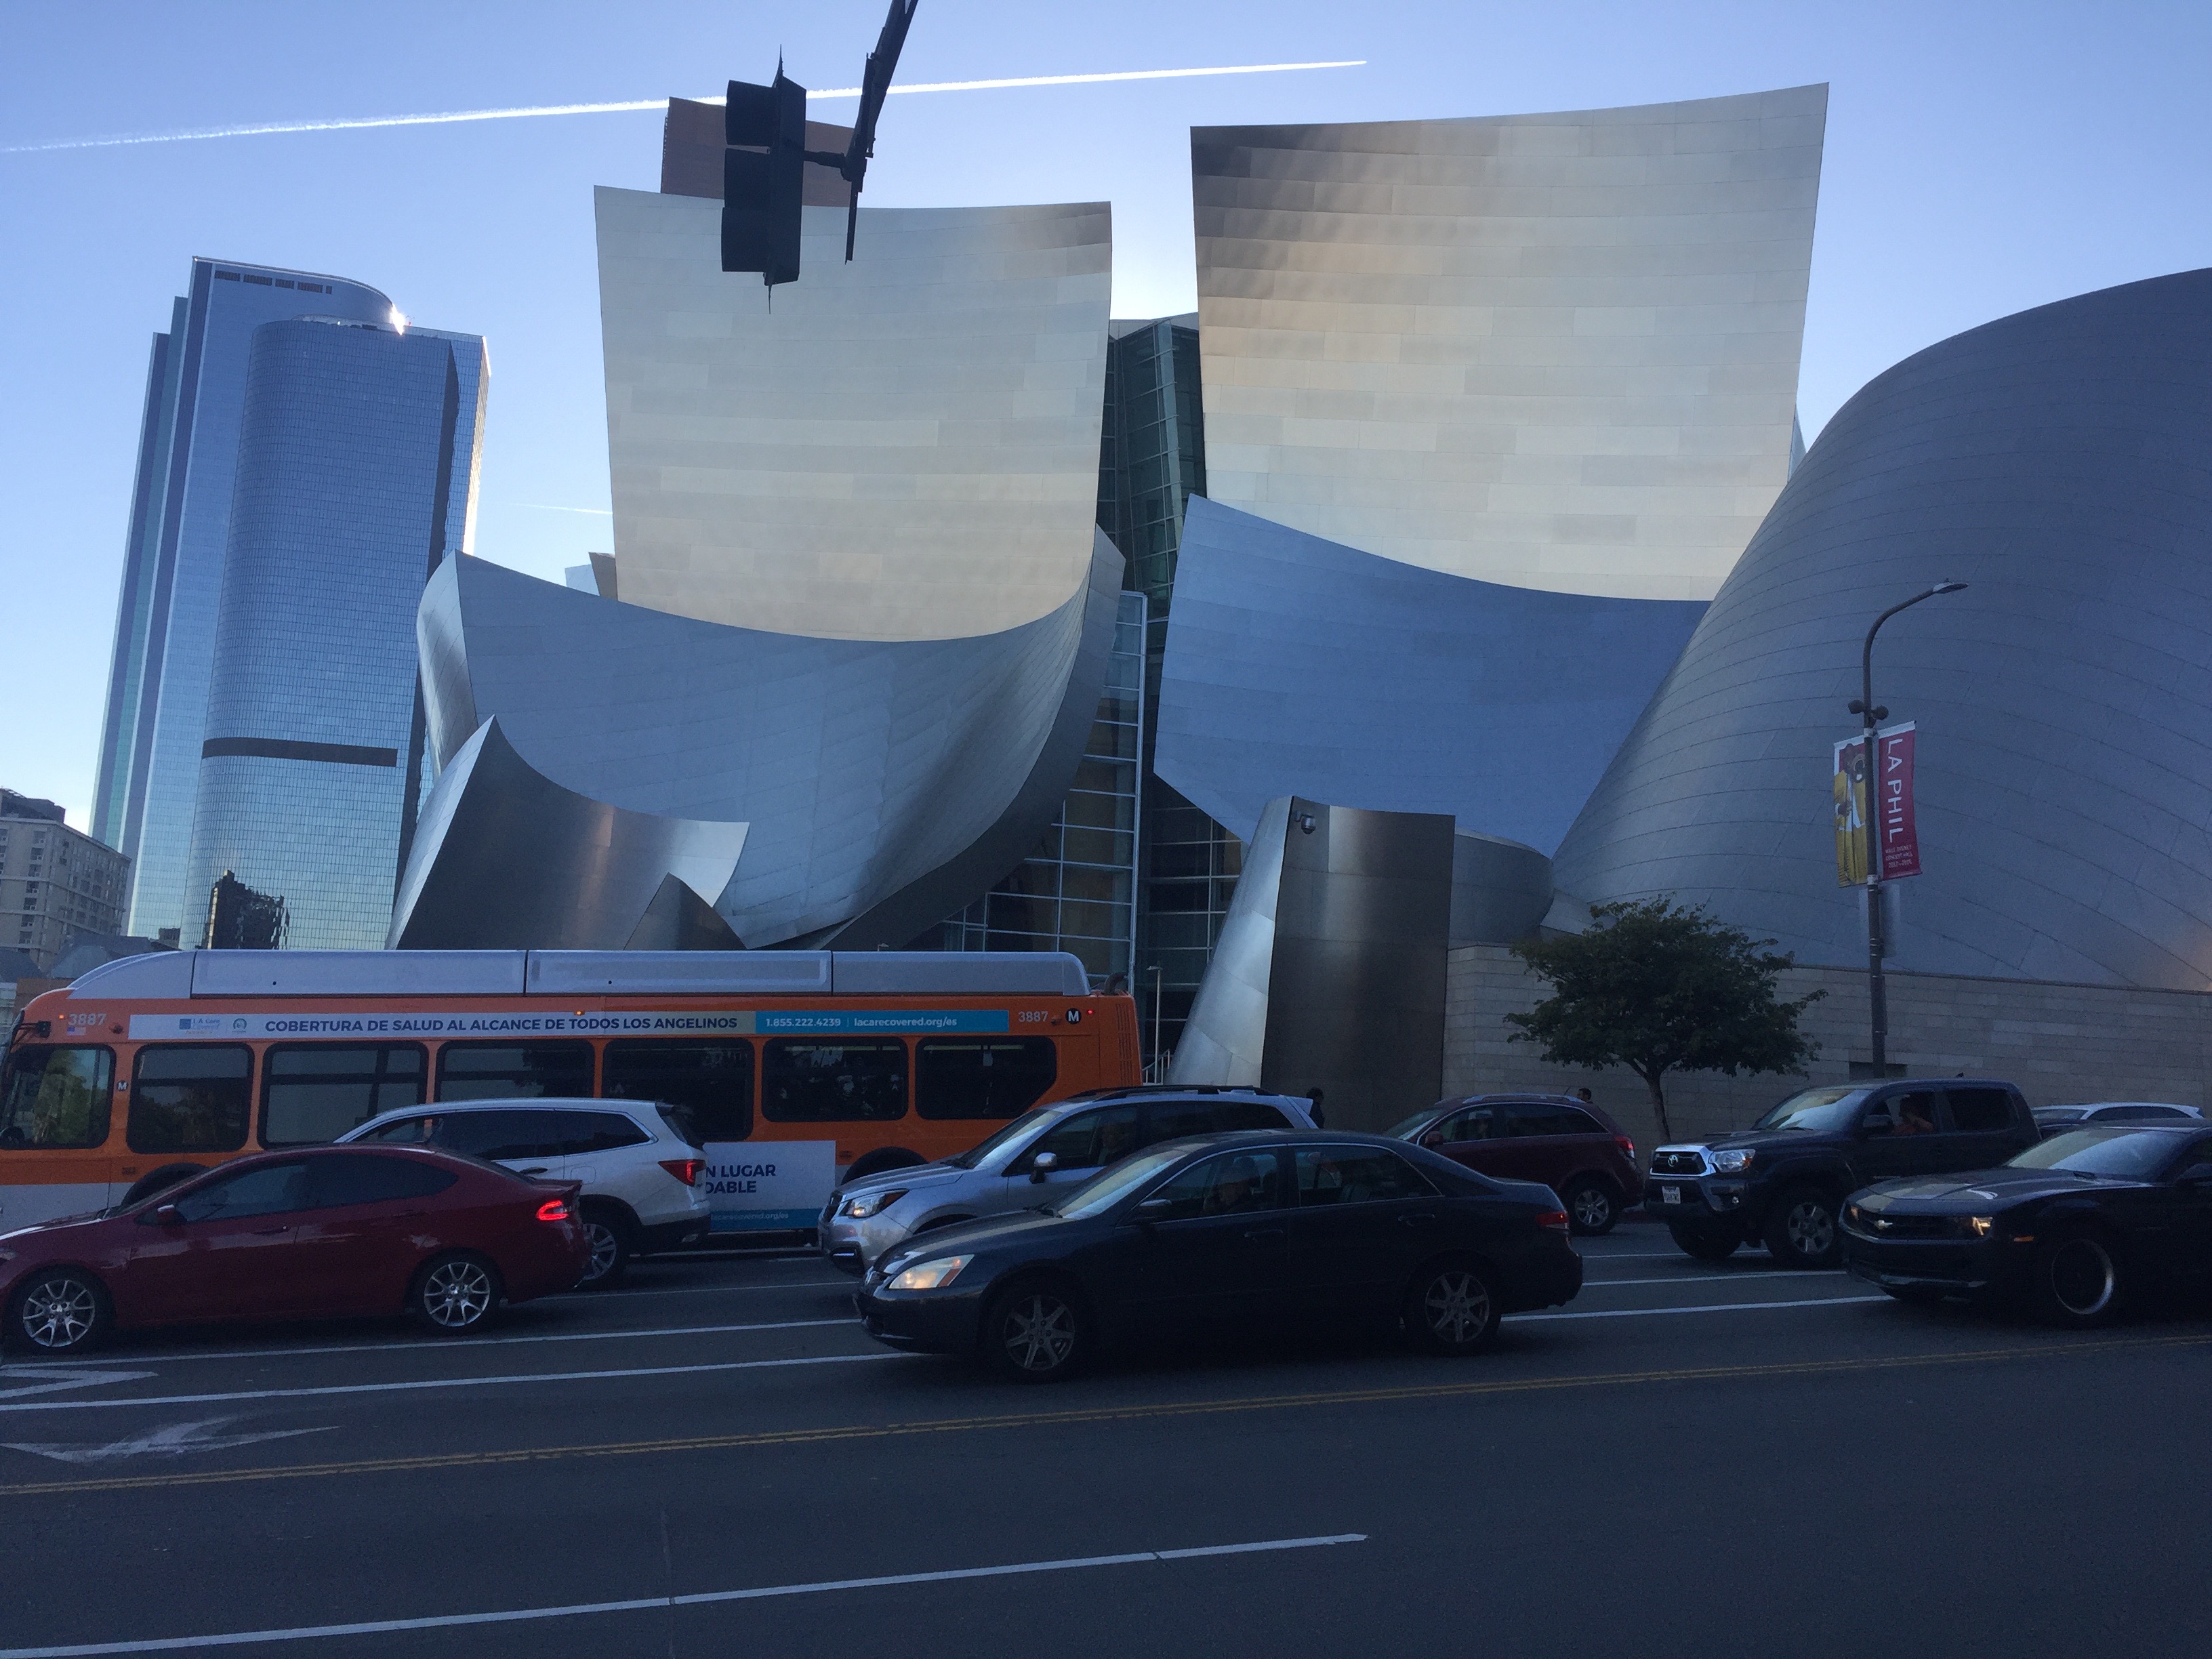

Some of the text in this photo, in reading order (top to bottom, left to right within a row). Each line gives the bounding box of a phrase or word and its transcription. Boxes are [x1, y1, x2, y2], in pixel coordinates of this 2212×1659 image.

[1887, 739, 1904, 842] LA PHIL
[68, 1013, 106, 1026] 3887
[766, 1017, 958, 1028] 1.855.222.4239 lacarecovered.org/es
[1018, 1010, 1048, 1023] 3887
[1067, 1010, 1080, 1023] M
[265, 1017, 737, 1032] COBERTURA DE SALUD AL ALCANCE DE TODOS LOS ANGELINOS
[720, 1164, 777, 1178] LUGAR
